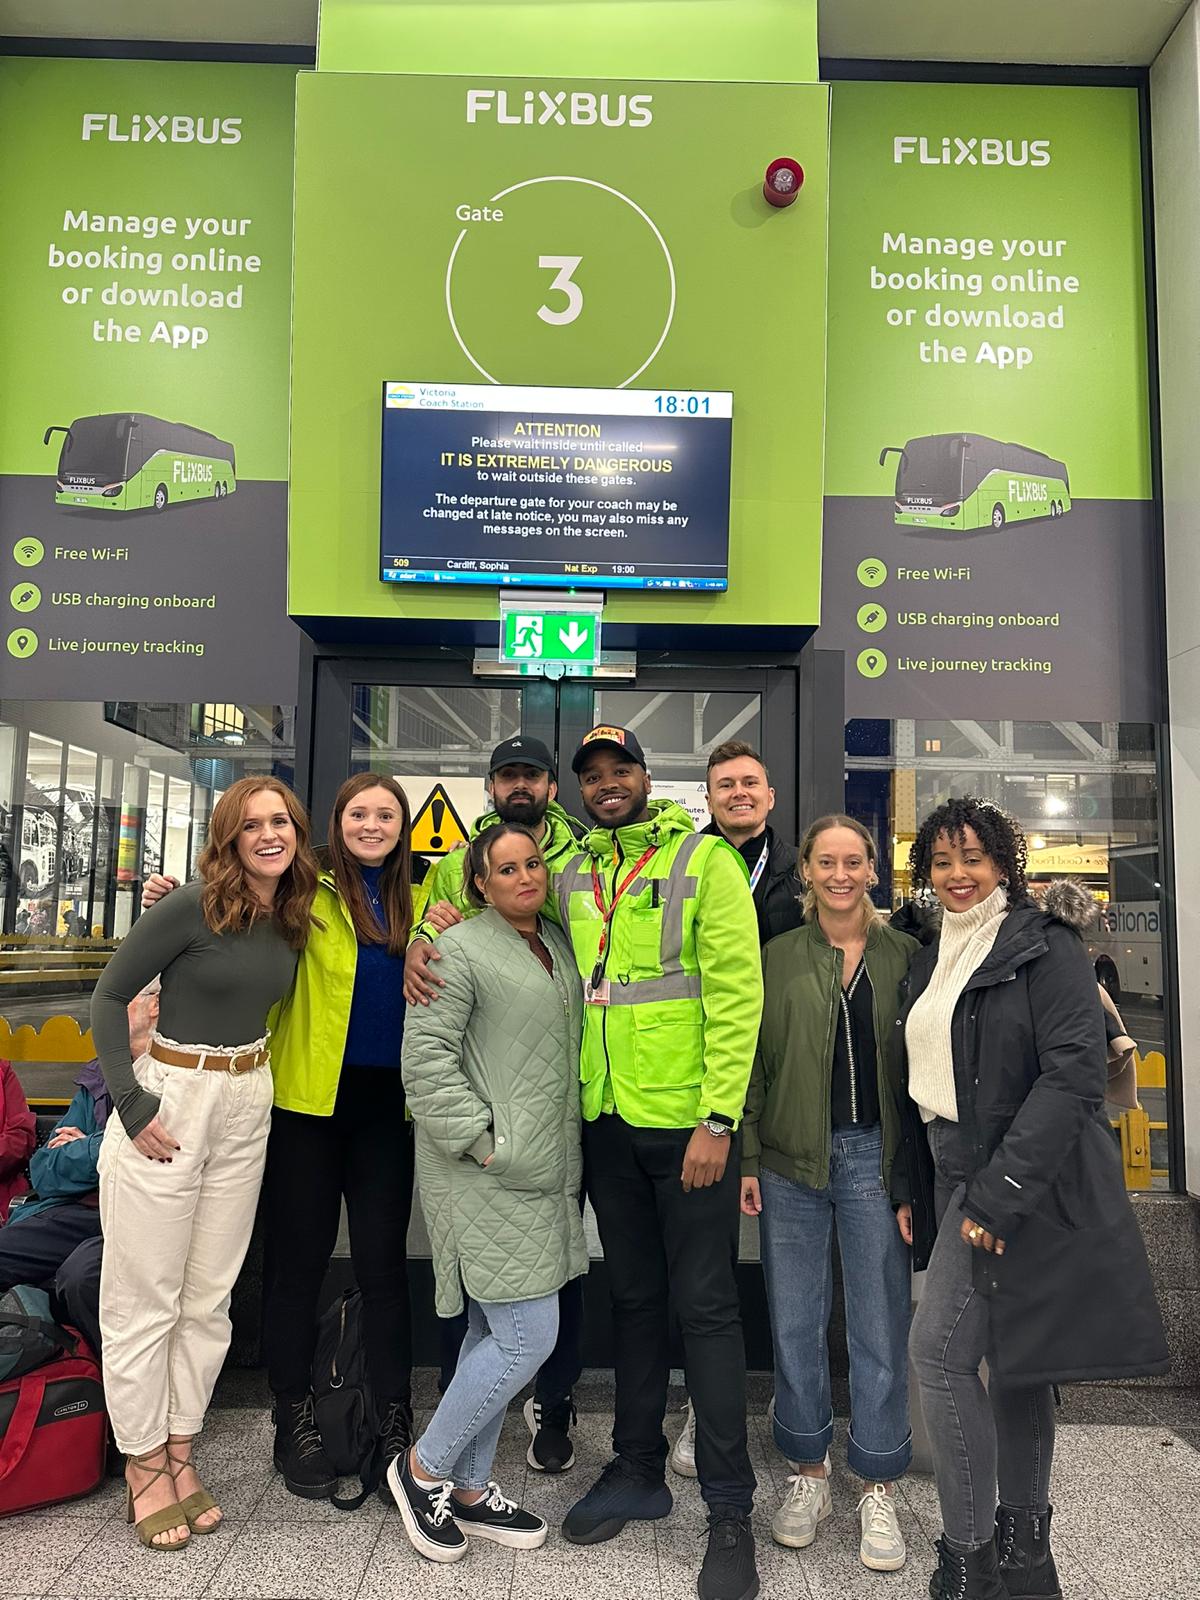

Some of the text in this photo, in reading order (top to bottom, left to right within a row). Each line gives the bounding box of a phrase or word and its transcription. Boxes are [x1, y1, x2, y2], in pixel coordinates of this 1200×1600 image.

[456, 204, 504, 222] Gate
[63, 210, 251, 239] Manage your
[882, 232, 1066, 261] Manage your
[48, 244, 261, 274] booking online
[870, 266, 1079, 296] booking online
[62, 282, 243, 308] or download
[536, 256, 583, 326] 3
[887, 304, 1064, 329] or download
[93, 320, 209, 348] the App
[919, 340, 1033, 369] the App
[419, 388, 456, 397] Victoria
[419, 399, 484, 409] Coach Station
[654, 396, 710, 414] 18:01
[514, 422, 601, 438] ATTENTION
[471, 436, 643, 453] Please wait inside until called
[441, 453, 673, 473] IT IS EXTREMELY DANGEROUS
[477, 471, 637, 487] to wait outside these gates.
[435, 493, 678, 513] The departure gate for your coach may be
[423, 507, 689, 527] changed at late notice, you may also miss any
[483, 524, 628, 538] messages on the screen.
[55, 547, 129, 561] Free Wi-Fi
[393, 558, 635, 574] 509 Cardiff, Sophia Nat Exp 19:00
[897, 567, 971, 580] Free Wi-Fi
[51, 593, 216, 609] USB charging onboard
[897, 613, 1059, 628] USB charging onboard
[49, 638, 204, 656] Live journey tracking
[898, 658, 1052, 673] Live journey tracking
